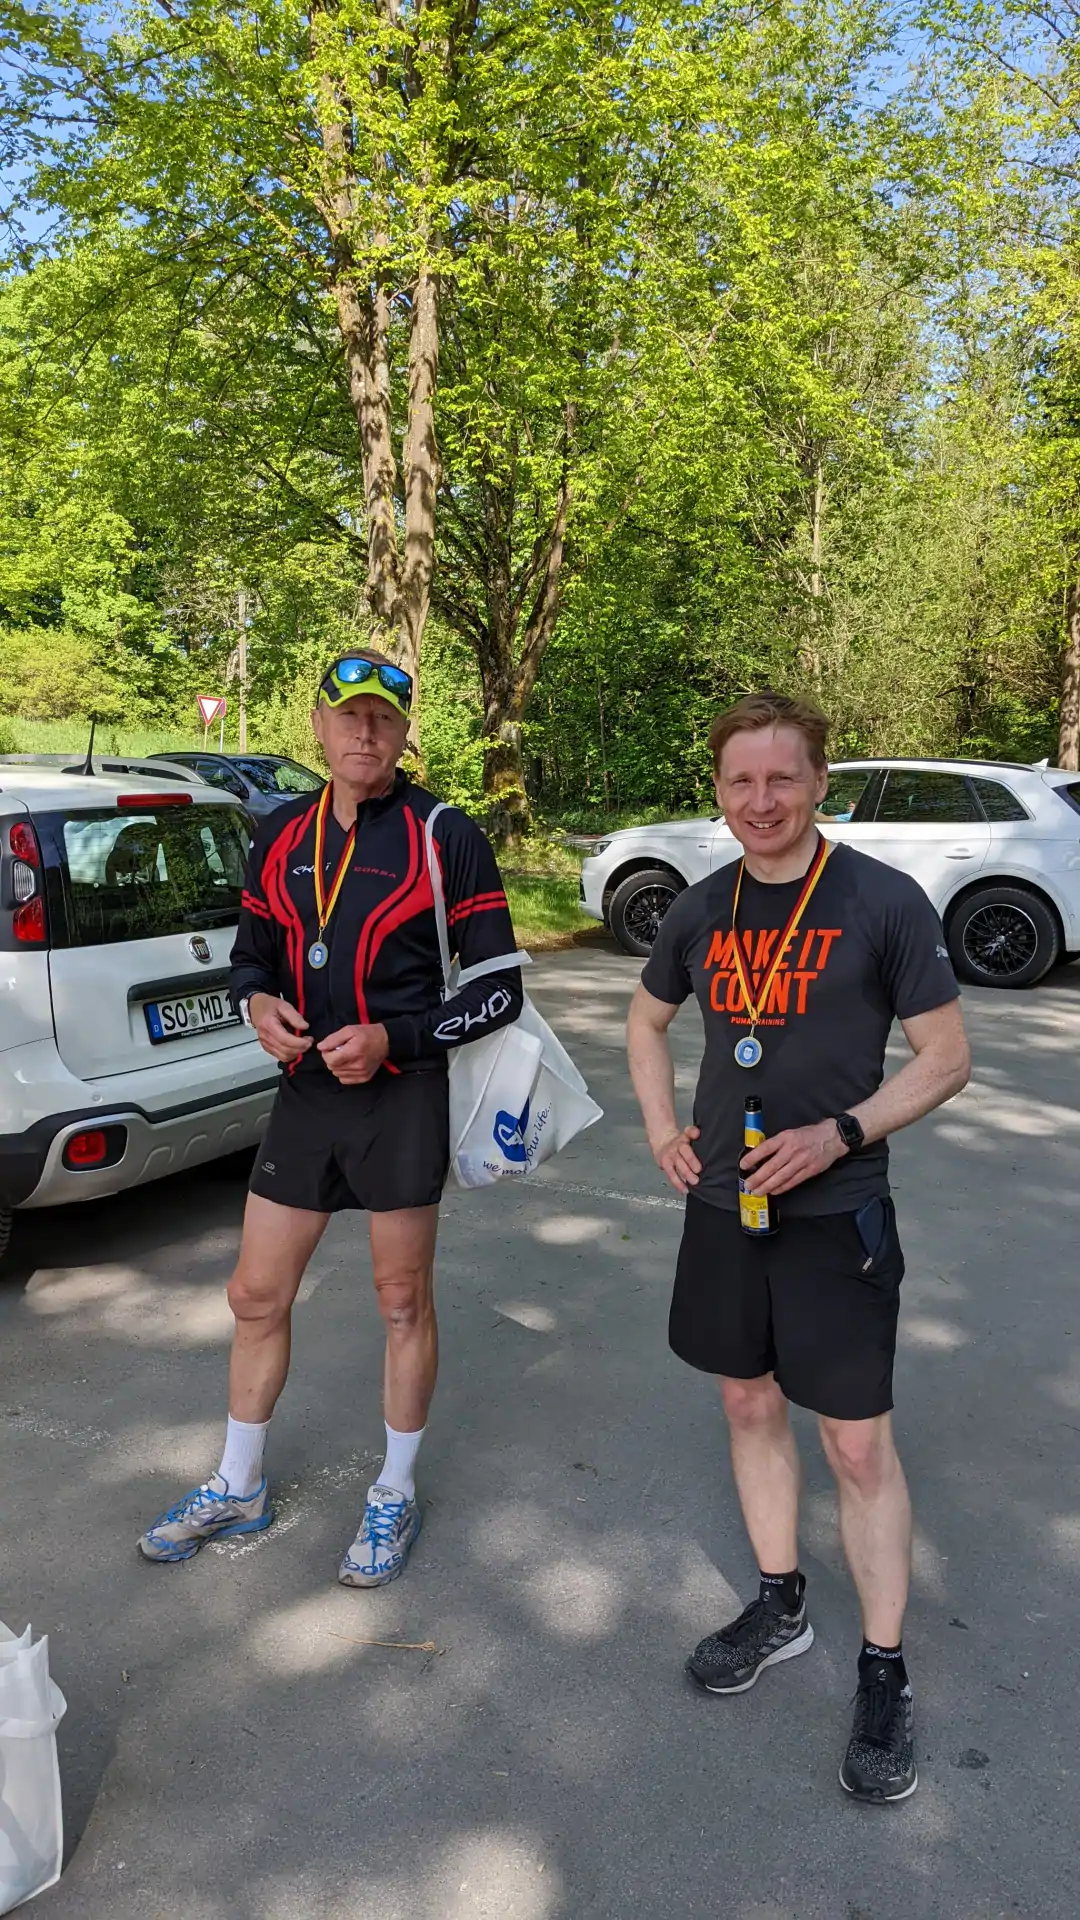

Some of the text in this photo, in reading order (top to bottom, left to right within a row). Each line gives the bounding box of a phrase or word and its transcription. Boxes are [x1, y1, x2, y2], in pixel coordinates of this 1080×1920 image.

[797, 929, 843, 970] IT
[161, 1002, 188, 1031] SO
[198, 995, 224, 1023] MD
[730, 1016, 785, 1026] PUMA RAINING
[483, 1161, 501, 1172] we
[526, 1132, 540, 1166] your
